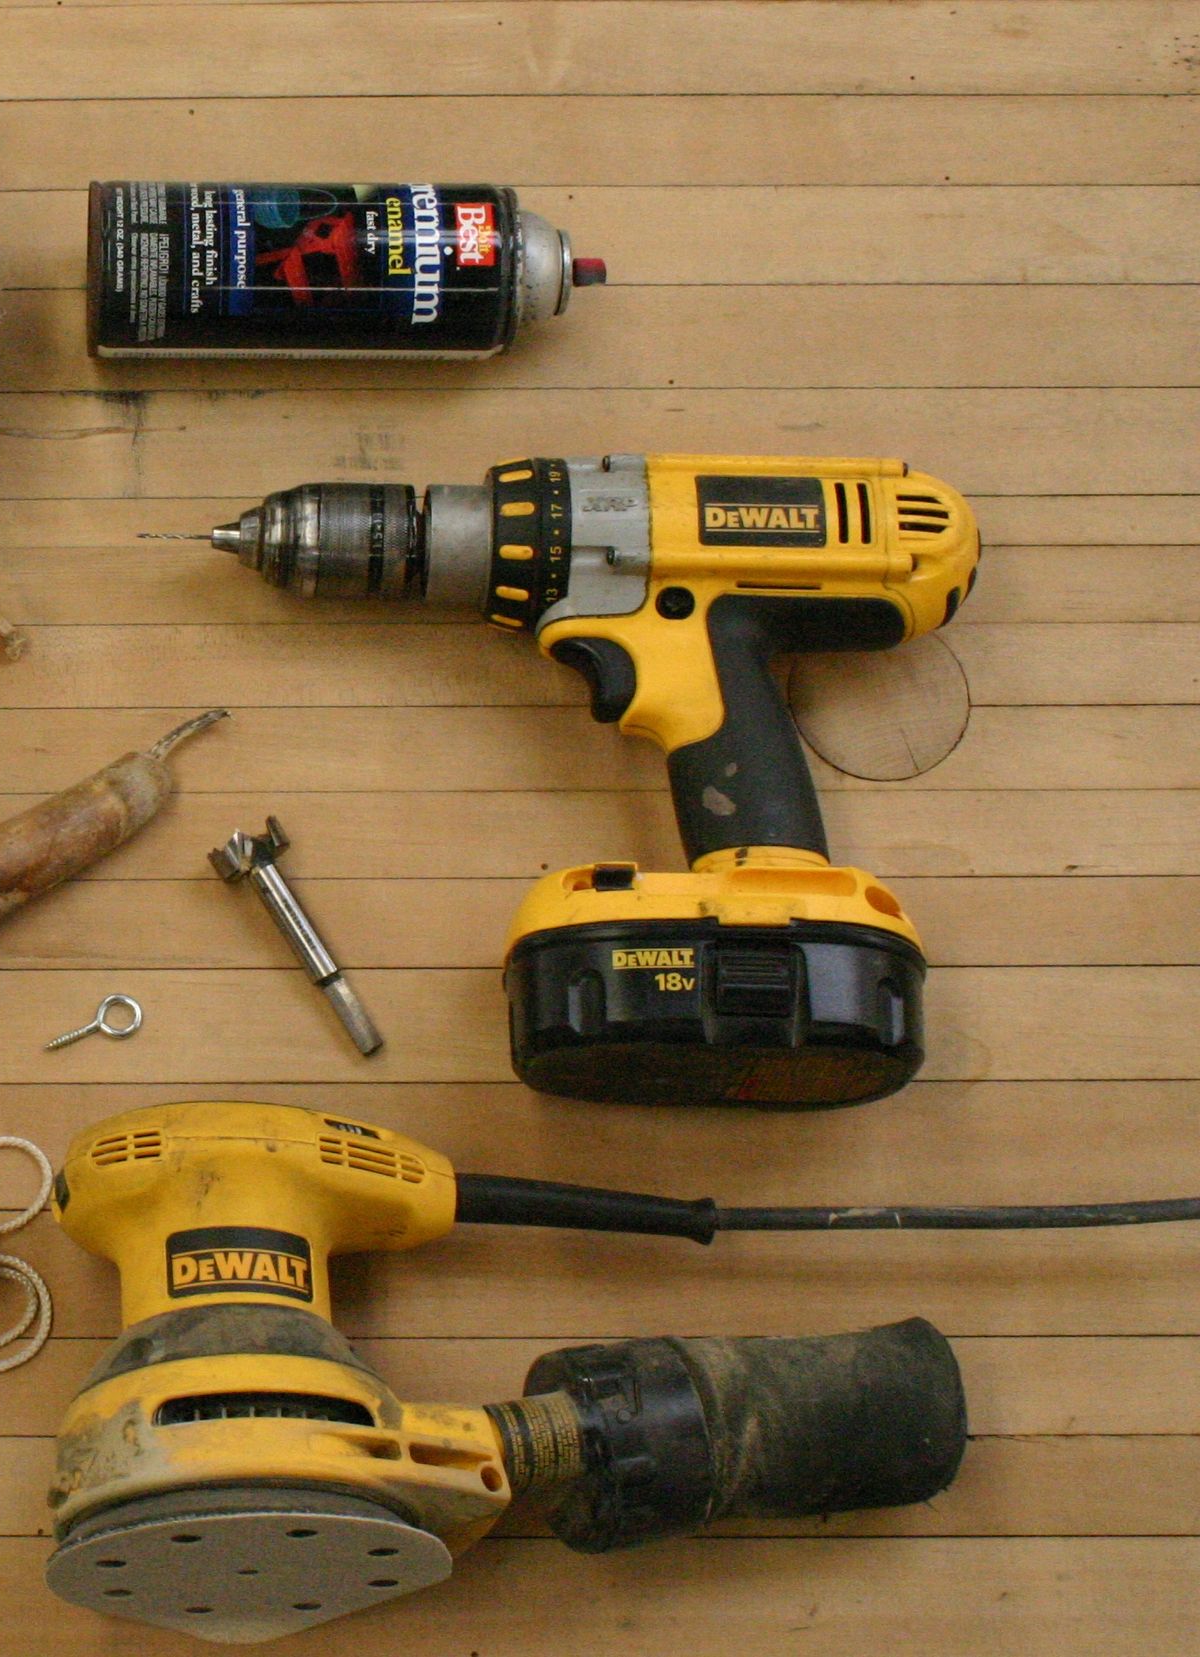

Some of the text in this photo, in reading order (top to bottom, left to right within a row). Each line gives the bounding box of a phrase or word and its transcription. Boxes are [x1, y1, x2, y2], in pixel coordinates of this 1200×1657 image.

[116, 219, 124, 228] 12
[190, 212, 204, 249] metal,
[202, 190, 218, 286] long lasting finish
[232, 188, 251, 289] general purpose
[365, 211, 378, 254] fast dry
[386, 198, 412, 275] enamel
[457, 205, 486, 264] Best
[191, 251, 204, 277] and
[190, 279, 204, 314] crafts
[548, 470, 562, 483] 19
[550, 503, 563, 519] 17
[705, 506, 818, 528] DEWALT
[549, 545, 562, 563] 15
[545, 588, 559, 603] 13
[613, 950, 693, 967] DEWALT
[172, 1252, 307, 1288] DEWALT
